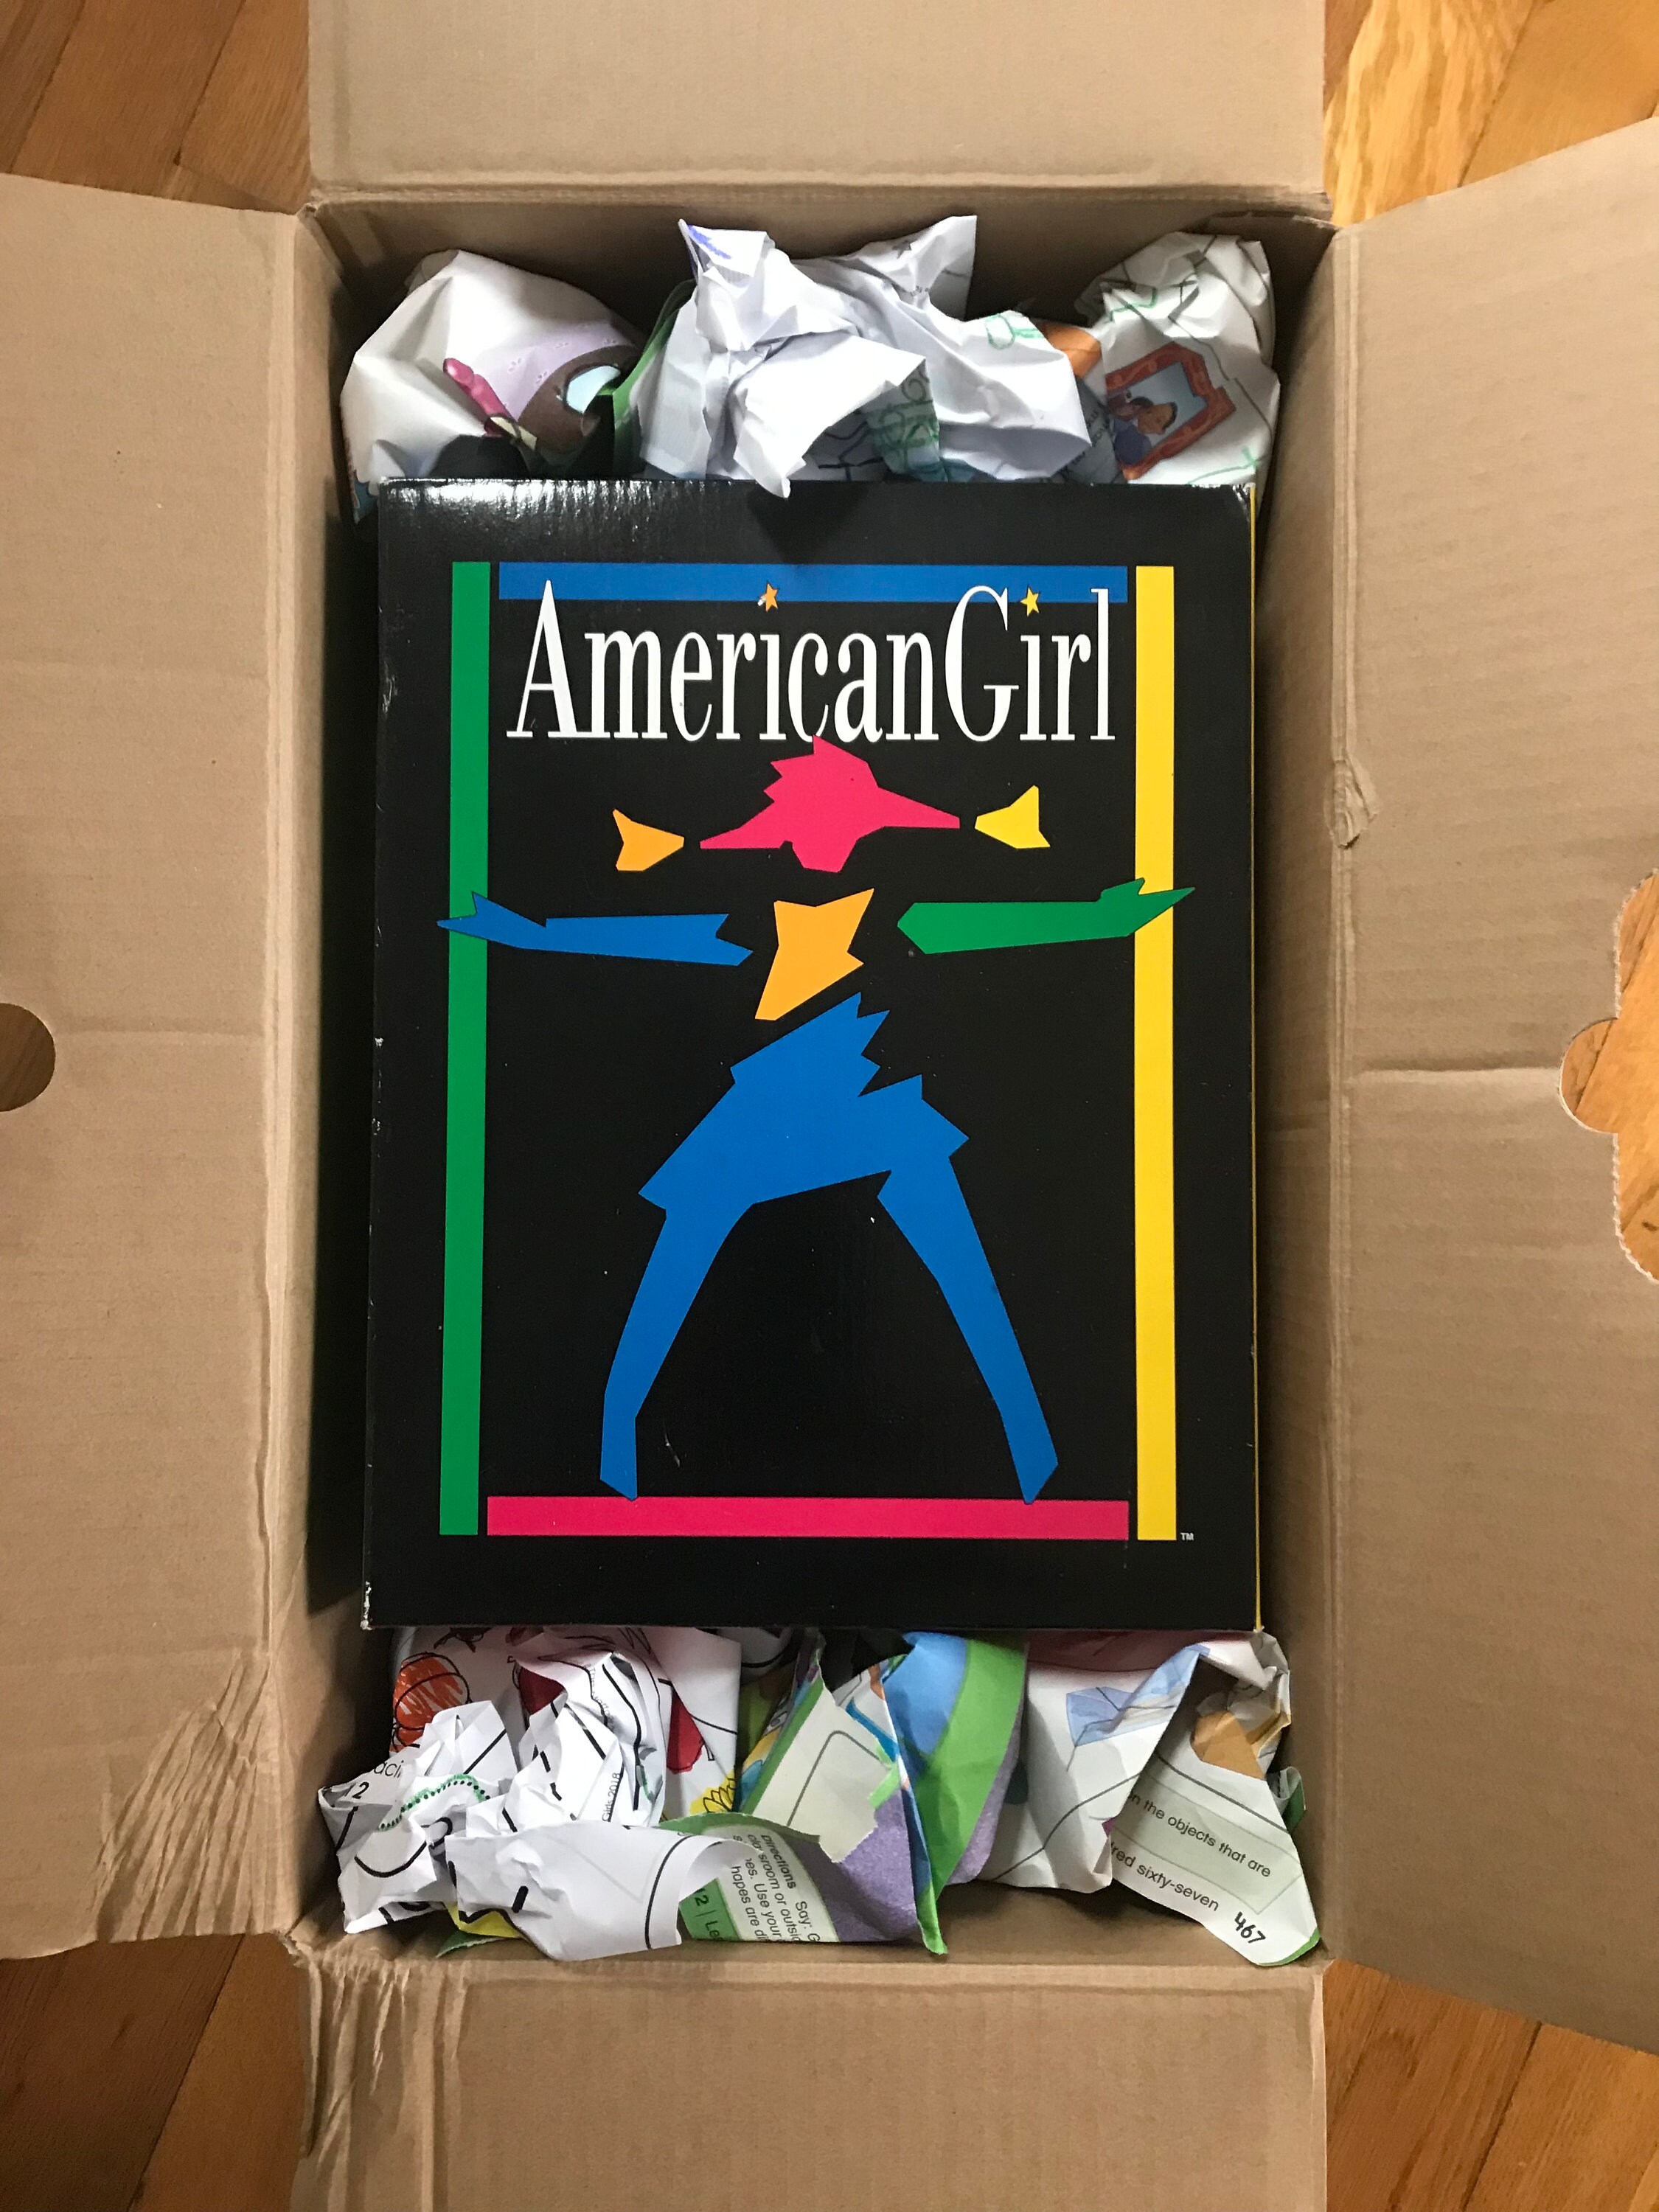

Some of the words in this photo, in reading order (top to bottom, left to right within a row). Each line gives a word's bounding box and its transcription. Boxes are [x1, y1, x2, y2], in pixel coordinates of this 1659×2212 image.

[1180, 1532, 1194, 1541] TM
[1144, 1799, 1165, 1819] the
[1167, 1815, 1217, 1846] objects
[1218, 1842, 1246, 1864] that
[1247, 1859, 1271, 1878] are
[748, 1834, 780, 1889] clasroom
[774, 1893, 787, 1905] or
[760, 1834, 796, 1889] Directions
[795, 1901, 813, 1929] Say:
[1110, 1841, 1136, 1868] red
[1136, 1863, 1220, 1912] sixty-seven
[1234, 1910, 1267, 1944] 467
[745, 1907, 759, 1927] are
[754, 1882, 770, 1908] Use
[760, 1910, 782, 1938] your
